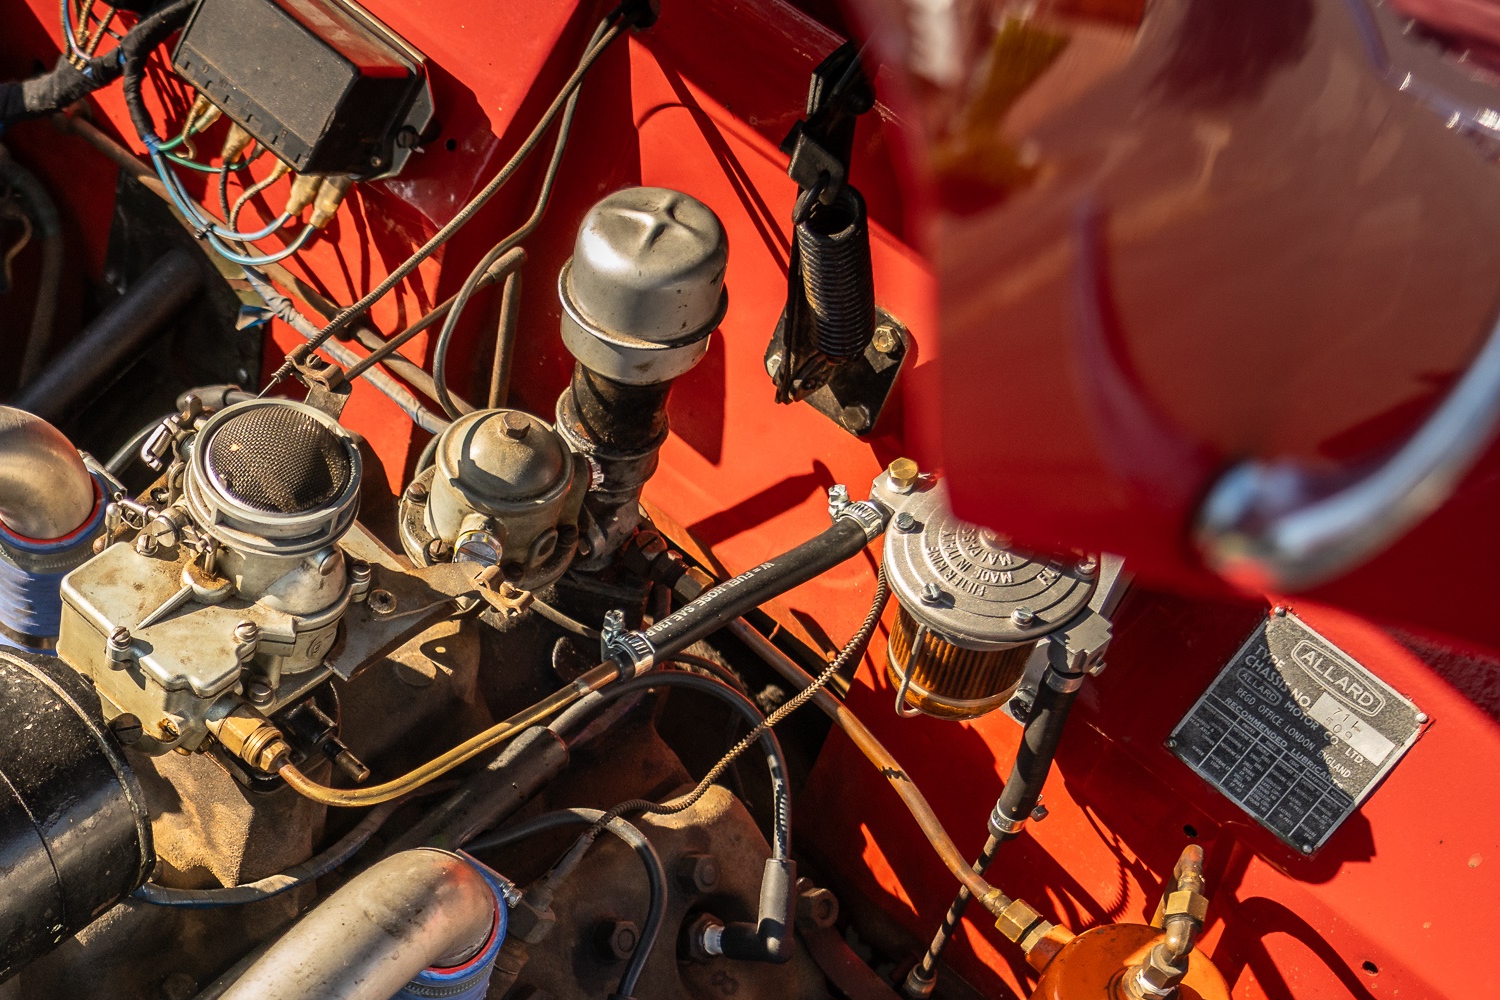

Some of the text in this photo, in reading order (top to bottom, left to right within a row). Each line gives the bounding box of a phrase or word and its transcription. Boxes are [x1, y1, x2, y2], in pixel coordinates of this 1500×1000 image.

[972, 566, 1013, 584] MADE
[692, 584, 725, 608] HOSE
[671, 602, 695, 622] SAE
[1253, 643, 1286, 672] TYPE
[1239, 670, 1278, 702] ALLARD
[1242, 652, 1314, 710] CHASSIS NO.
[1299, 647, 1376, 709] ALLARD
[1223, 696, 1288, 748] RECOMMENDED
[1289, 747, 1344, 790] LUBRICANTS
[1283, 699, 1365, 767] MOTOR CO. LTD.
[1322, 715, 1353, 742] 509
[1315, 748, 1352, 779] ENGLAND
